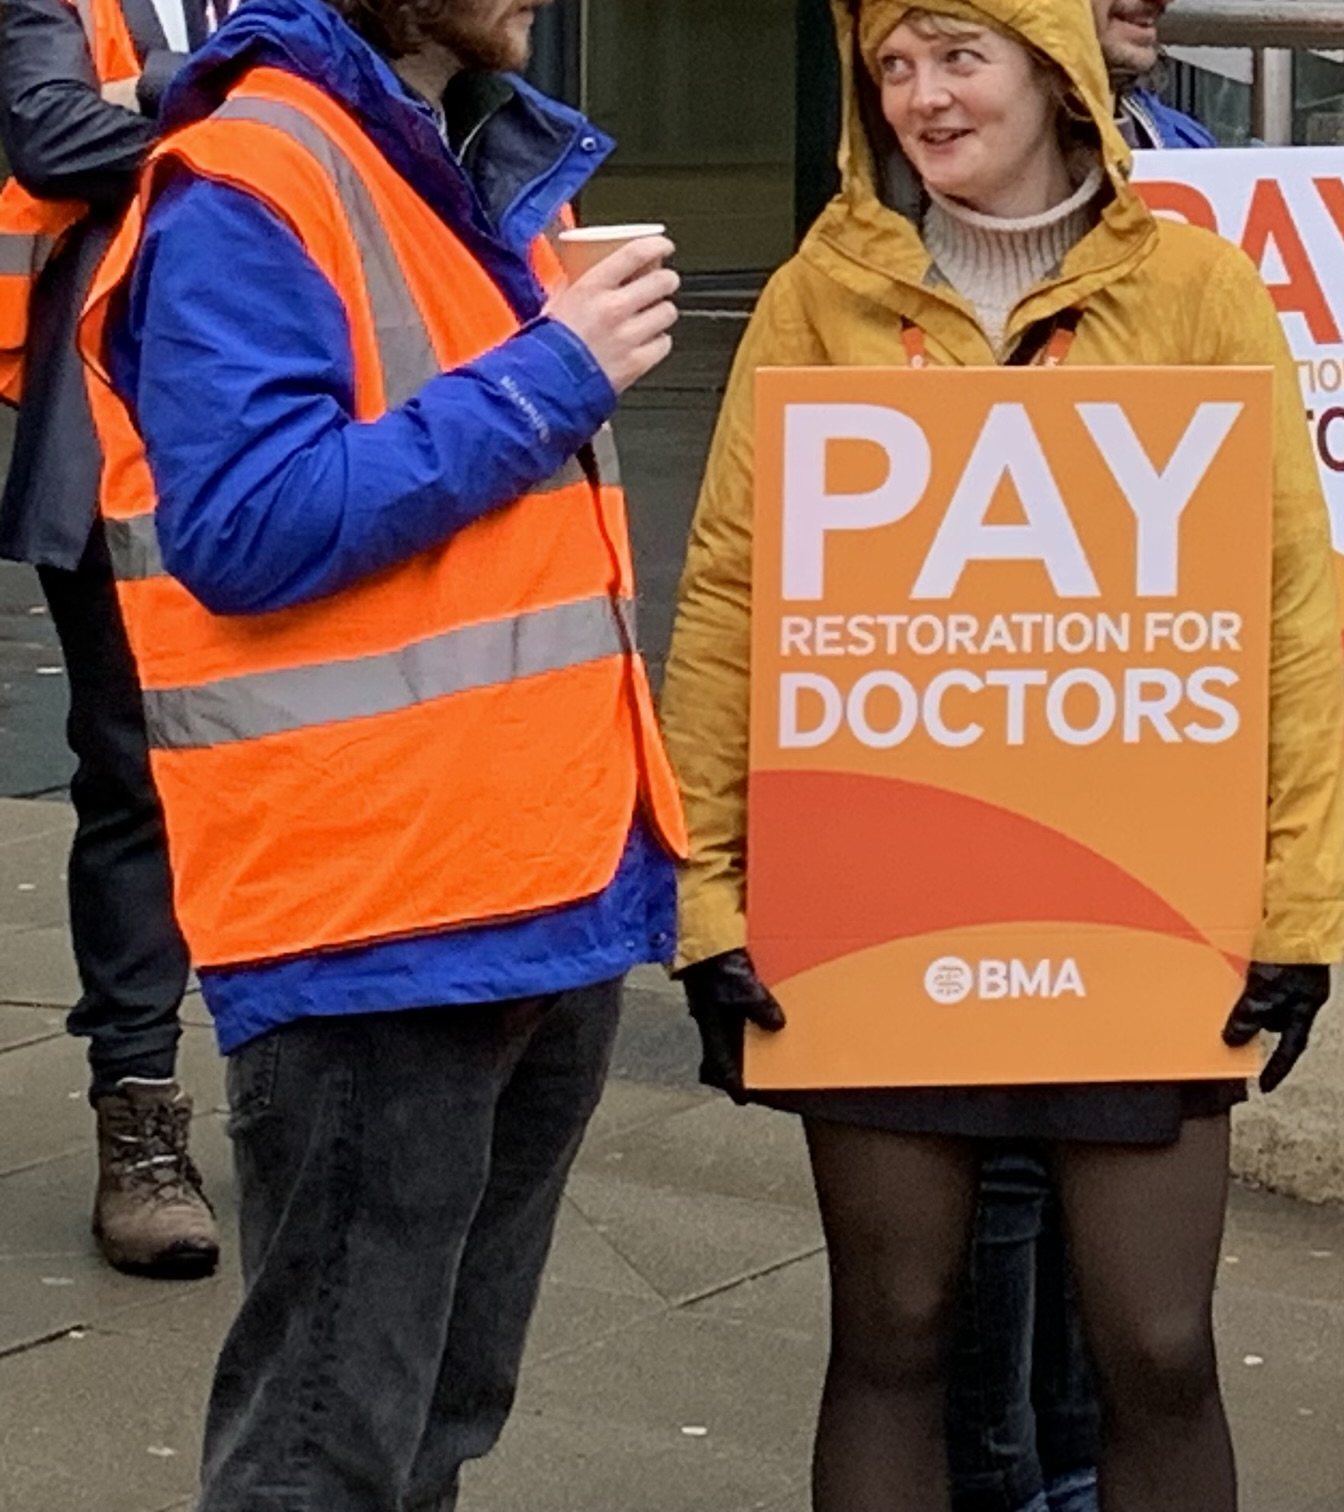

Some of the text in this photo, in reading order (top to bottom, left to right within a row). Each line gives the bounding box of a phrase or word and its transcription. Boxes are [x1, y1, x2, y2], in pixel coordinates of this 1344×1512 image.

[781, 401, 1246, 601] PAY
[780, 610, 1242, 656] RESTORATION FOR
[778, 665, 1241, 749] DOCTORS
[978, 958, 1087, 1000] BMA
